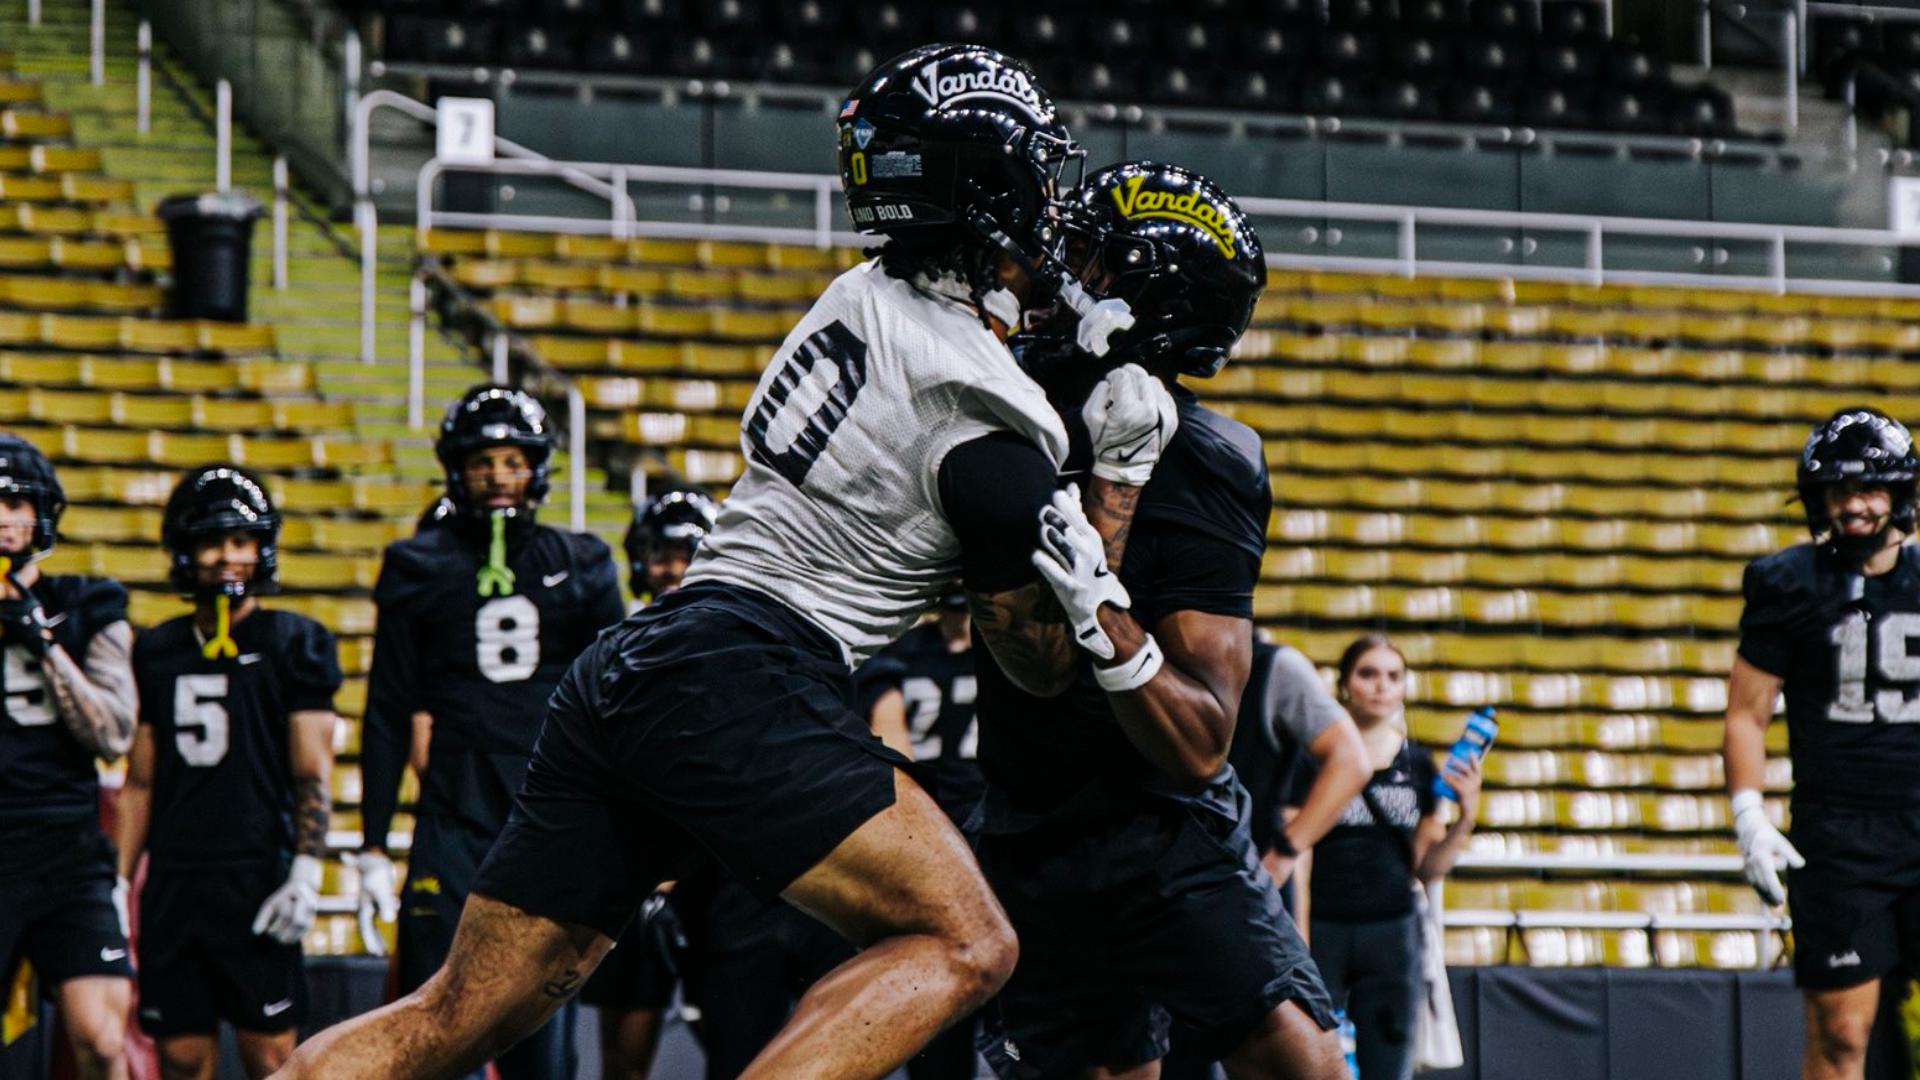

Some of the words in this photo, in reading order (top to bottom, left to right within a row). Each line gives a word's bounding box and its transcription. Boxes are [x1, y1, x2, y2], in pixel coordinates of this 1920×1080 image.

[850, 151, 868, 187] 0
[875, 204, 914, 221] BOLD
[744, 318, 868, 489] 0
[474, 593, 541, 685] 8
[172, 672, 231, 769] 5
